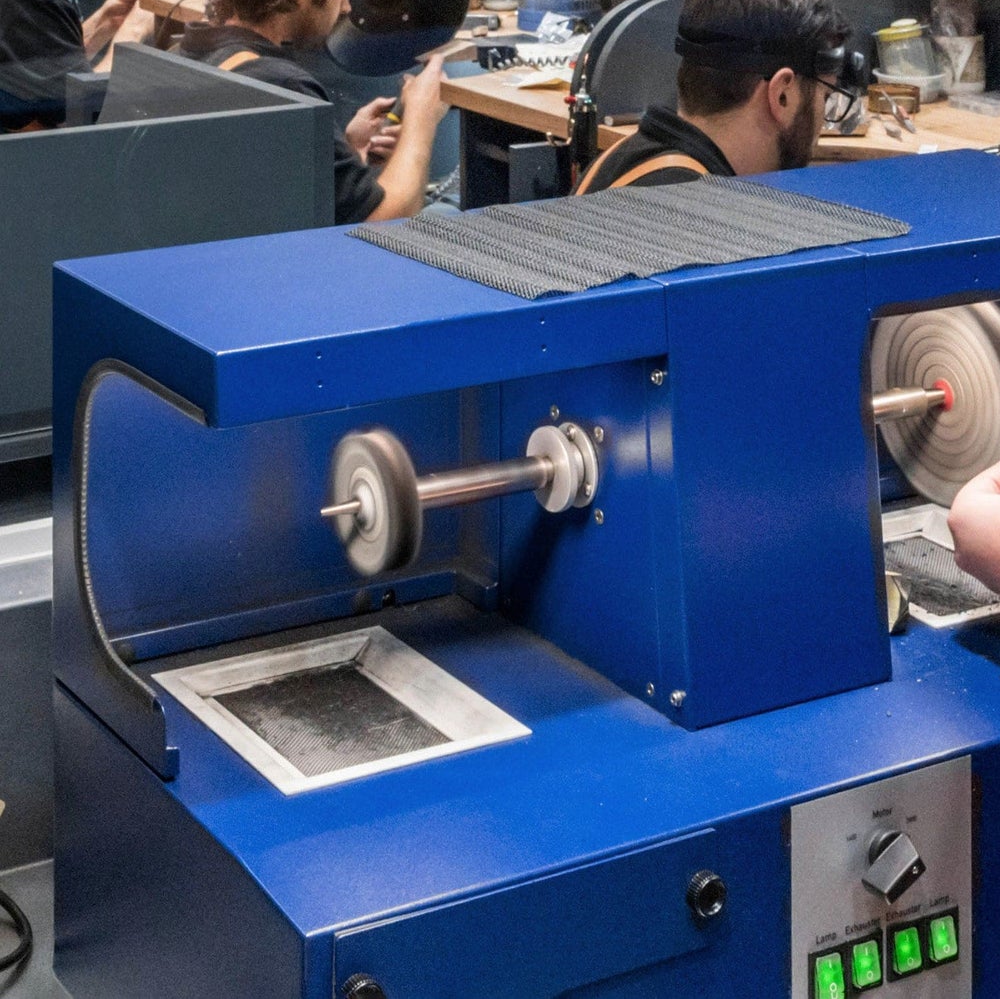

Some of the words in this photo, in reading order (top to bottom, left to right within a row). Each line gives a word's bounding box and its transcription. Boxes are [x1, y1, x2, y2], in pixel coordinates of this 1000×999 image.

[872, 808, 893, 819] Motor
[816, 931, 837, 945] Lamp
[886, 904, 921, 921] Exhauster
[929, 895, 950, 907] Lamp
